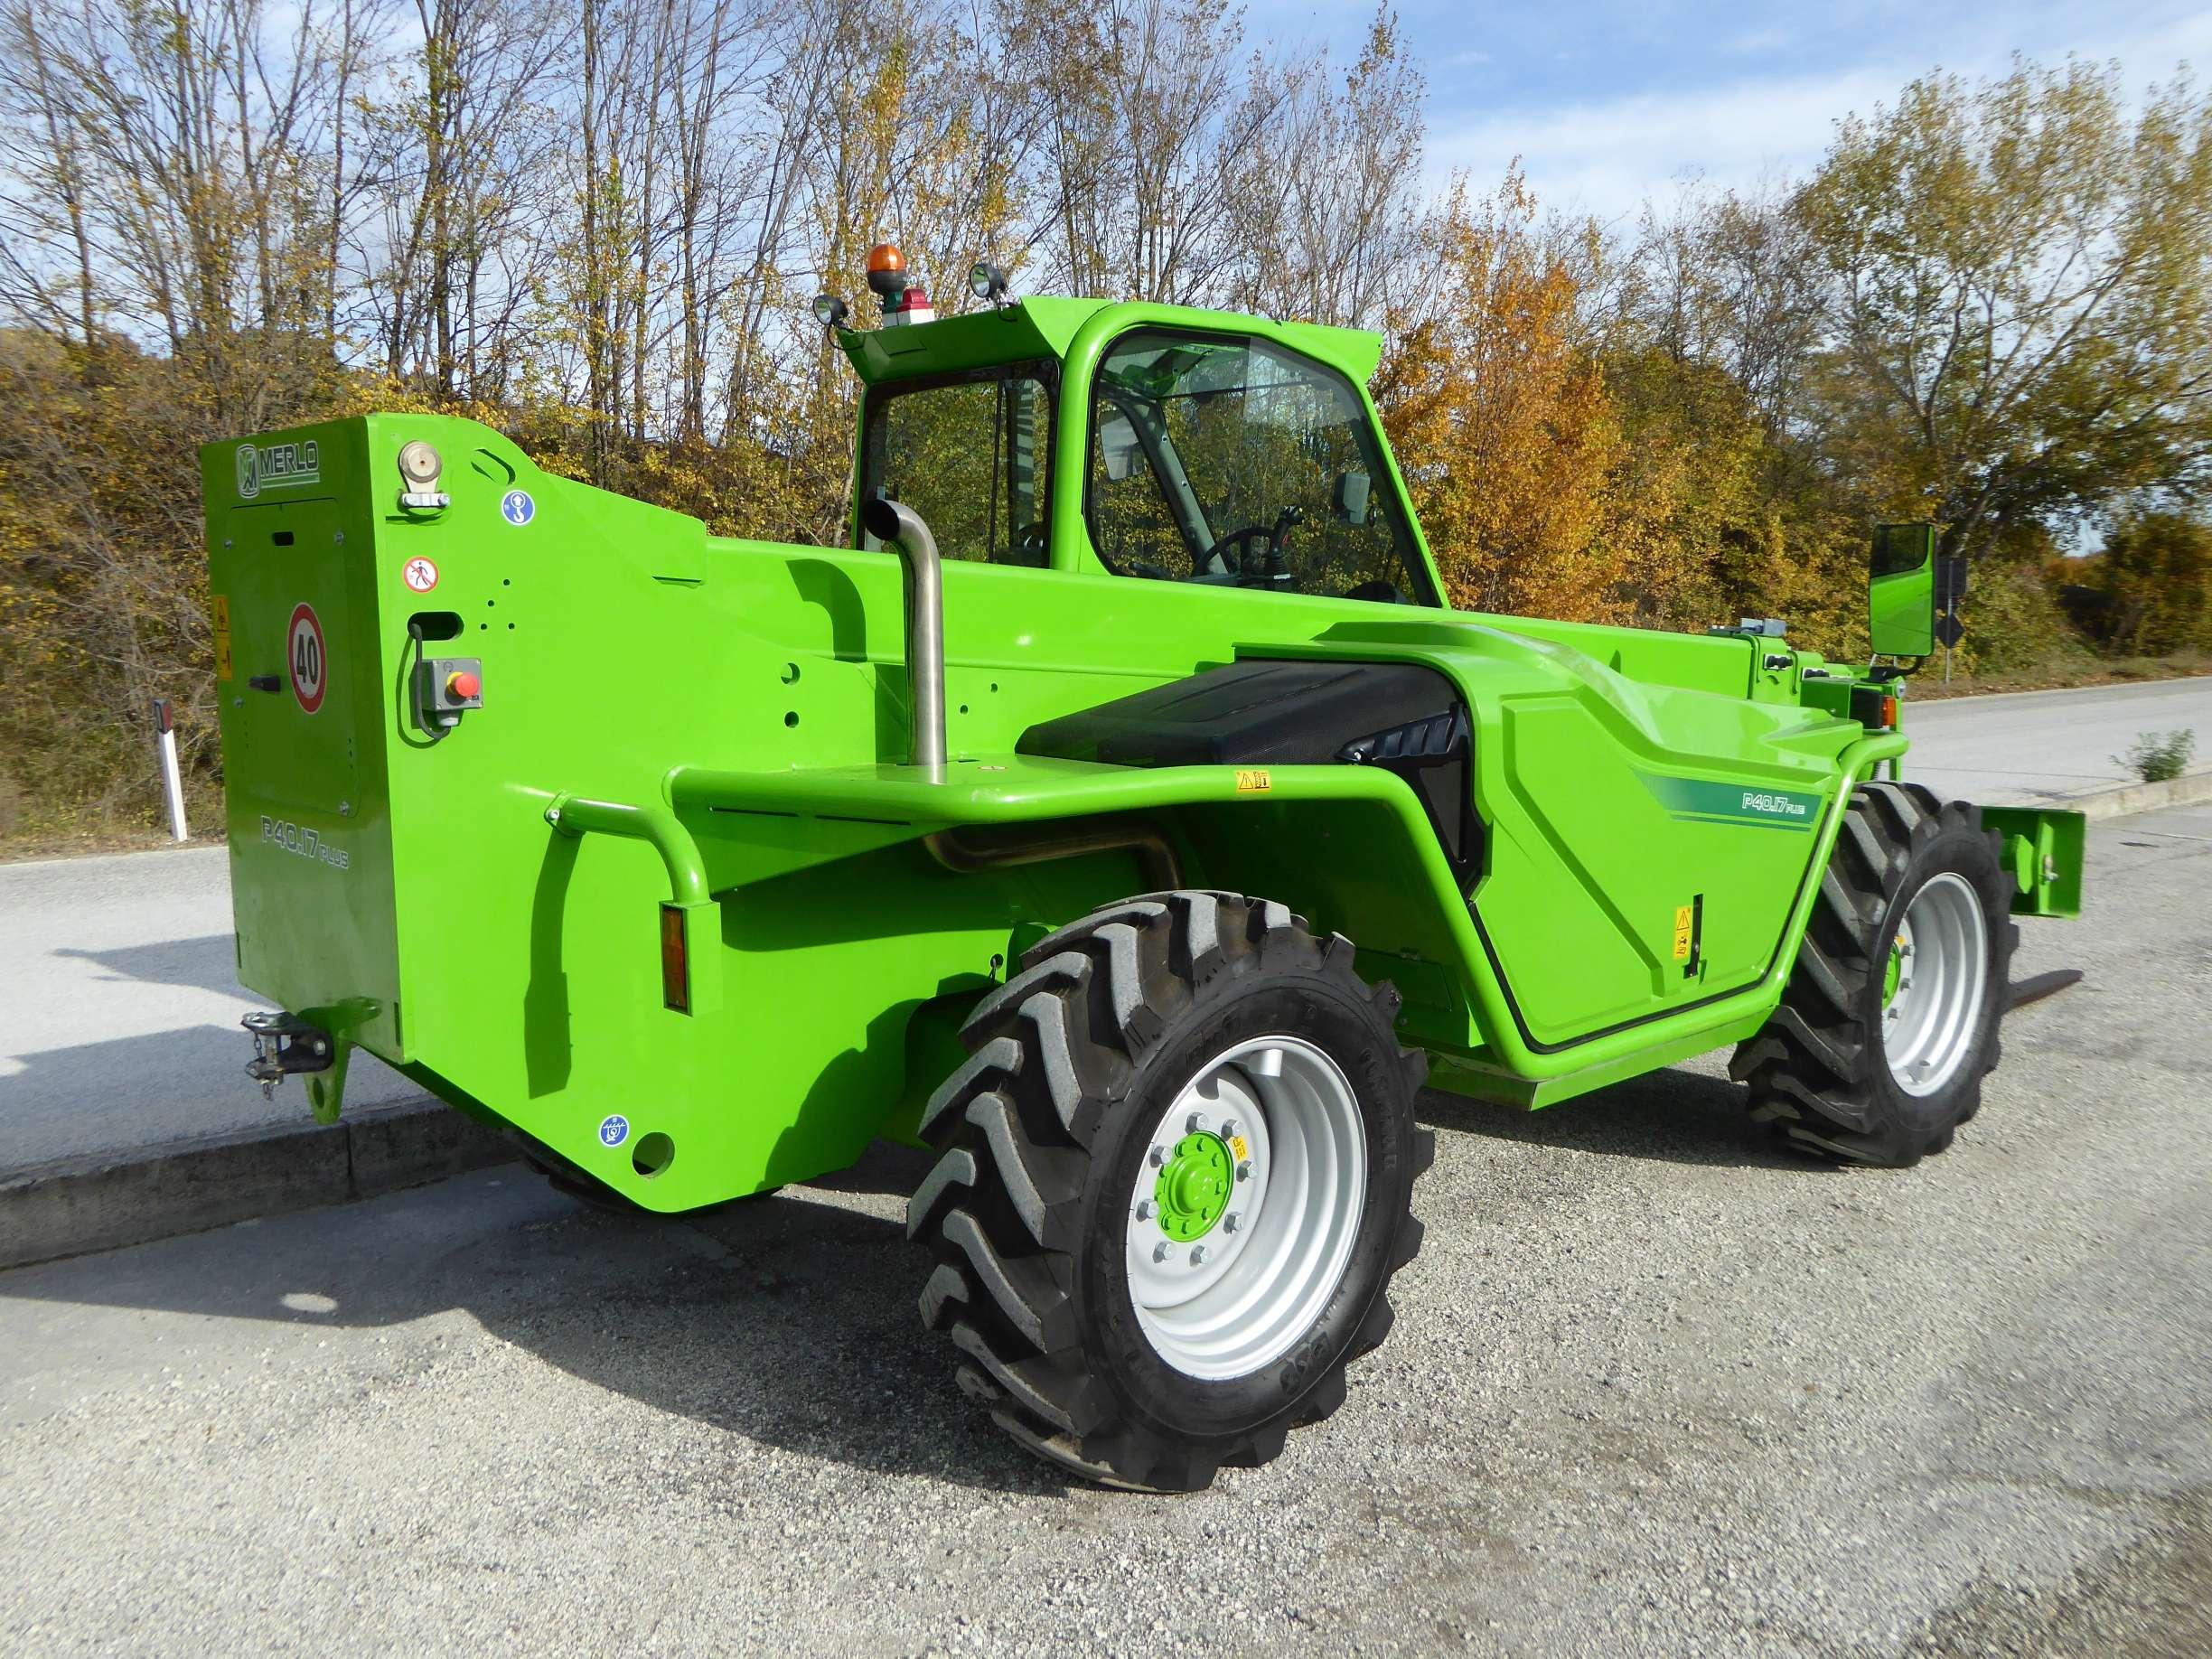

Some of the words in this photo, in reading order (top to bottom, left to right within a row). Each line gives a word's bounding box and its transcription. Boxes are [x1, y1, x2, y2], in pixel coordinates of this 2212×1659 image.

[258, 440, 319, 478] MERLO
[296, 633, 319, 685] 40
[1741, 792, 1788, 812] P40.17
[1786, 803, 1805, 815] PLUS
[260, 815, 319, 858] P40.17
[319, 843, 349, 869] PLUS
